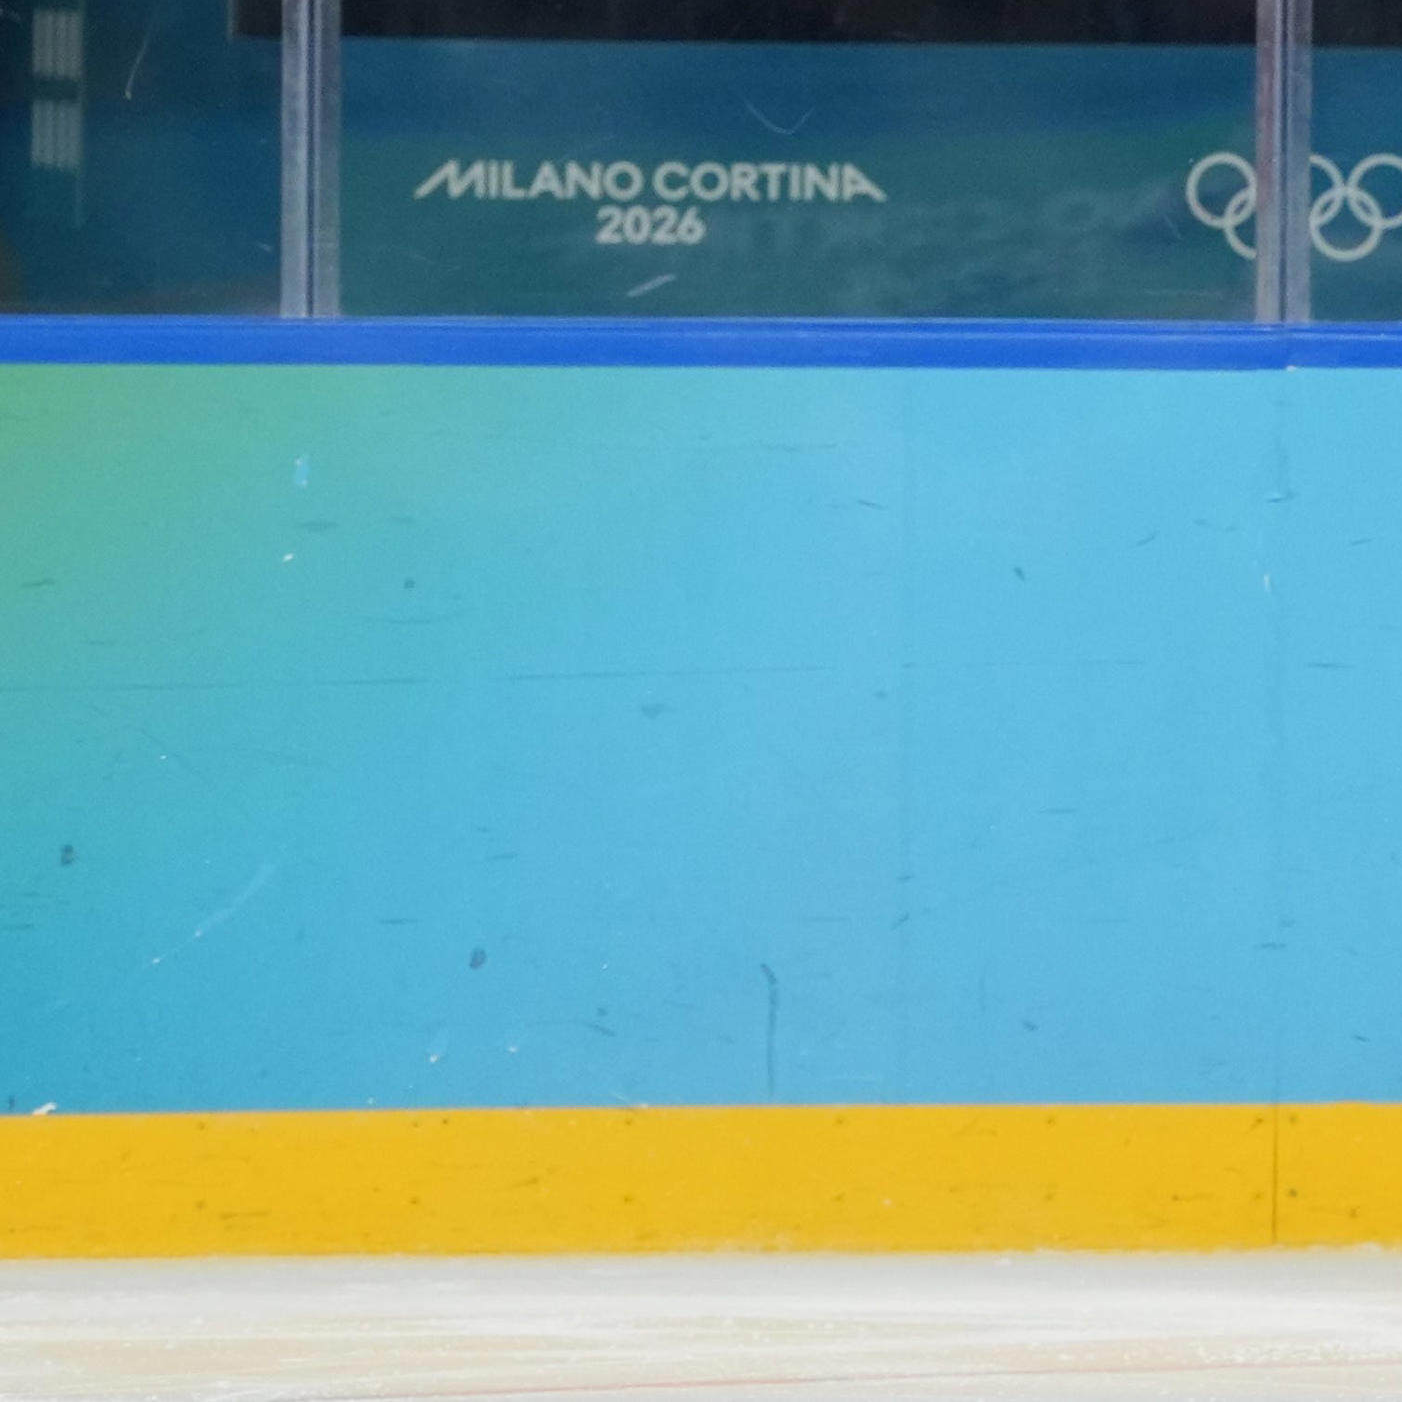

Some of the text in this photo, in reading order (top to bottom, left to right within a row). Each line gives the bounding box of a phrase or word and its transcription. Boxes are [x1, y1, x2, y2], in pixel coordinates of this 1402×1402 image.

[414, 159, 888, 202] MILANO CORTINA
[595, 204, 706, 245] 2026
